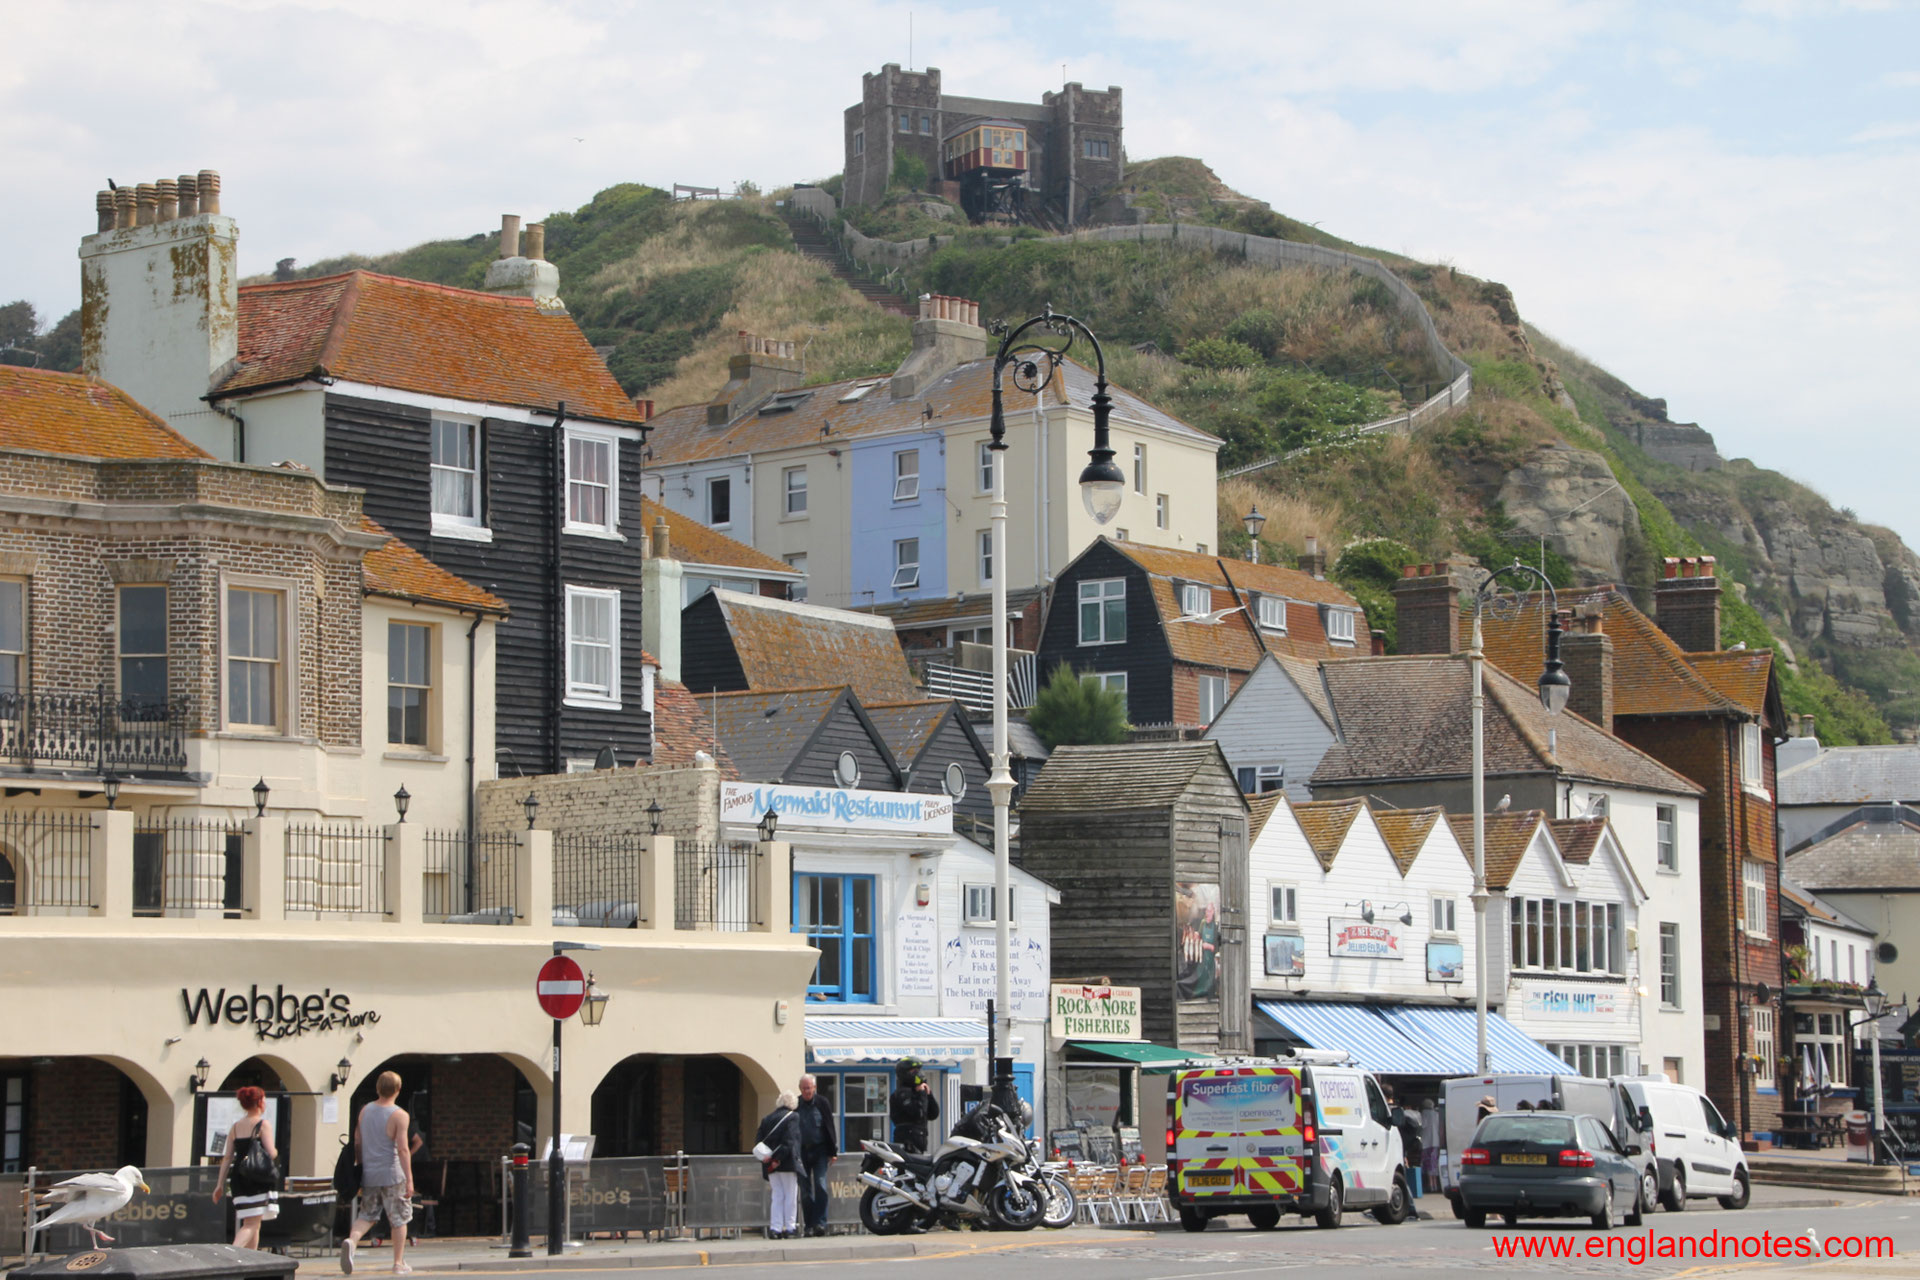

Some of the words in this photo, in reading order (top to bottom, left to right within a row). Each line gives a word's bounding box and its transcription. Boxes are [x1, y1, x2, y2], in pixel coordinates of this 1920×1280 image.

[725, 787, 738, 797] THE
[723, 792, 754, 813] FAMOUS
[751, 787, 831, 819] Mermaid
[832, 791, 924, 823] Restaurant
[924, 800, 939, 808] FULLY
[923, 804, 952, 821] LICENSED
[1358, 927, 1369, 937] NET
[1369, 927, 1385, 937] SHOP
[968, 936, 997, 946] Merma
[970, 950, 977, 958] &
[972, 962, 987, 971] Fish
[989, 963, 996, 971] &
[958, 975, 971, 984] Eat
[973, 975, 980, 984] in
[945, 988, 959, 997] The
[961, 988, 976, 997] best
[978, 988, 997, 997] Britis
[1028, 989, 1045, 998] meal
[181, 984, 351, 1025] Webbe's
[1057, 996, 1093, 1015] ROCK
[1101, 997, 1137, 1016] NORE
[1064, 1017, 1130, 1035] FISHERIES
[1192, 1082, 1248, 1096] Superfast
[1251, 1080, 1279, 1093] fibre
[1240, 1108, 1282, 1120] openreach
[570, 1187, 631, 1206] ebbe's
[831, 1181, 868, 1198] Webb
[106, 1200, 188, 1222] ebbe's
